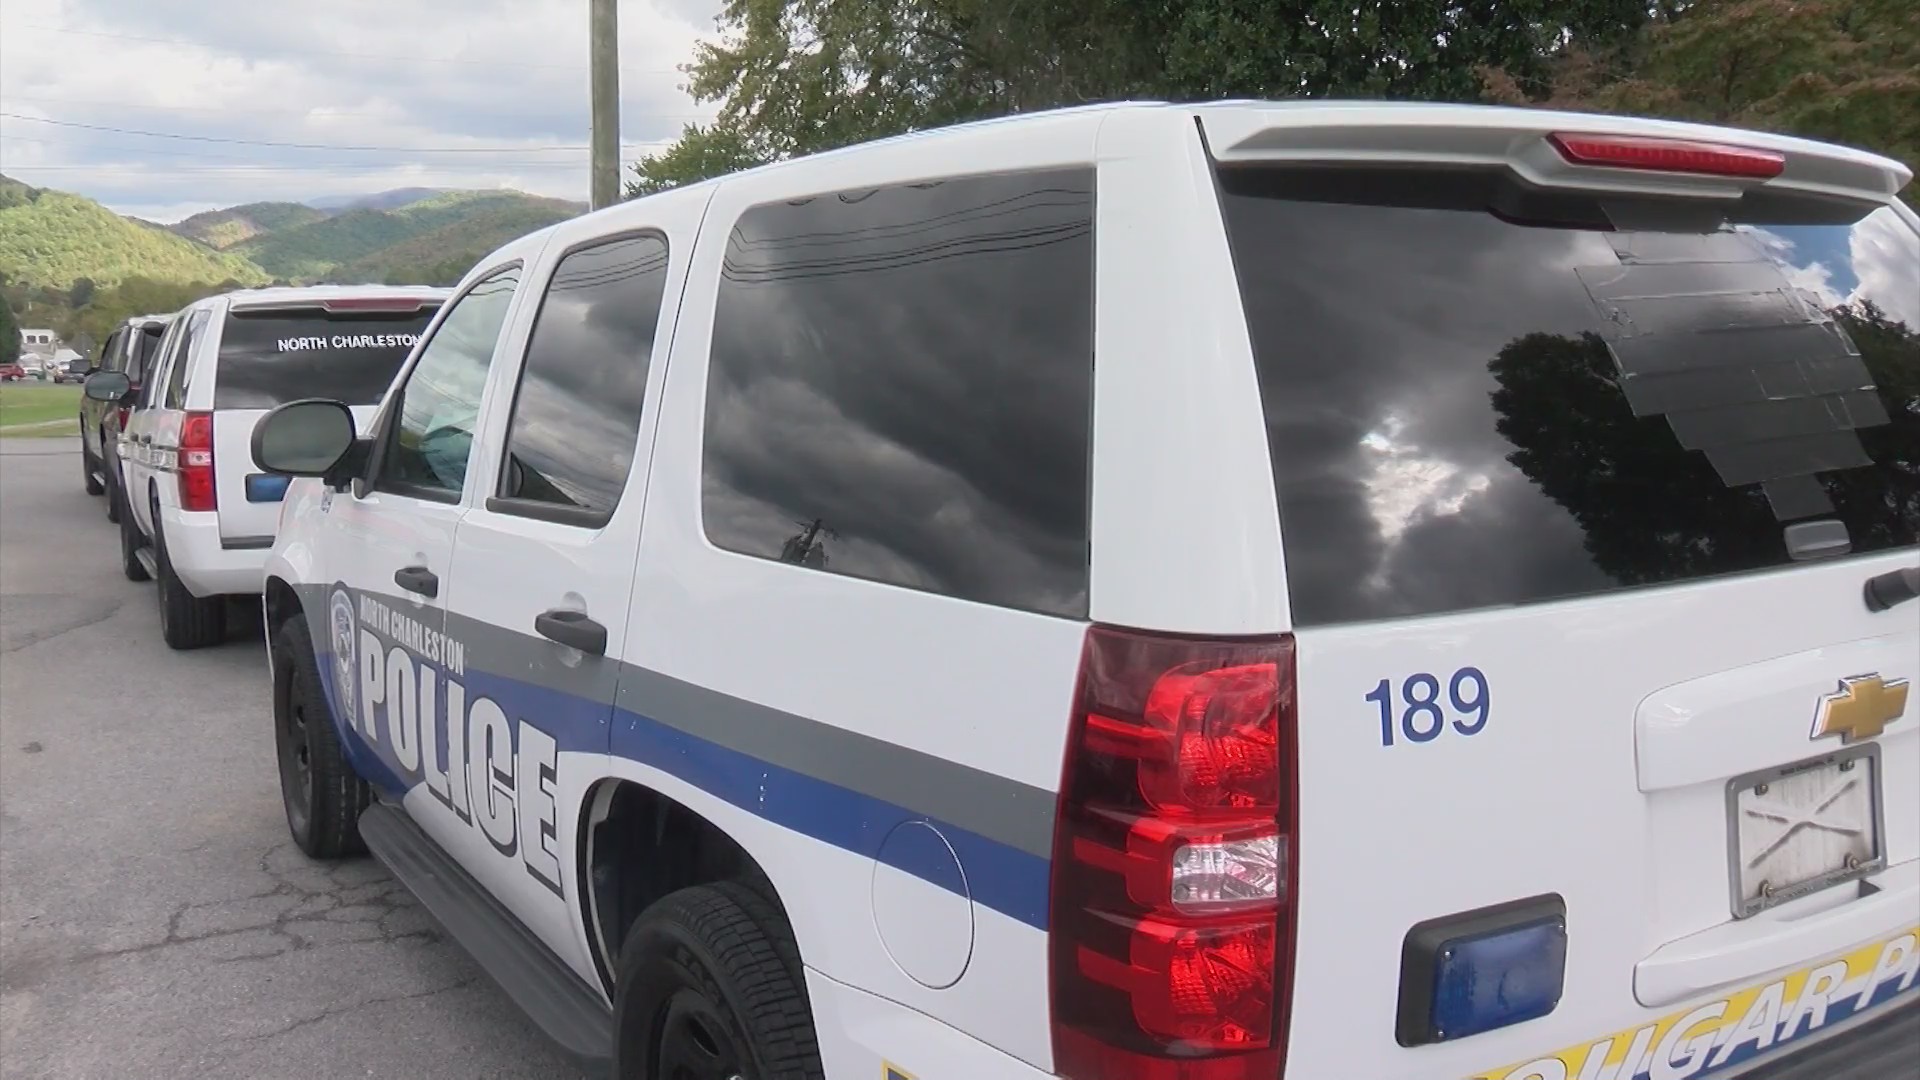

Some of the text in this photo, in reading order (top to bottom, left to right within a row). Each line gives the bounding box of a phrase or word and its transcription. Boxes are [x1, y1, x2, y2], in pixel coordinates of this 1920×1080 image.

[277, 335, 328, 351] NORTH
[360, 594, 464, 677] NORTH CHARLESTON
[1365, 666, 1490, 746] 189
[360, 629, 565, 902] POLICE
